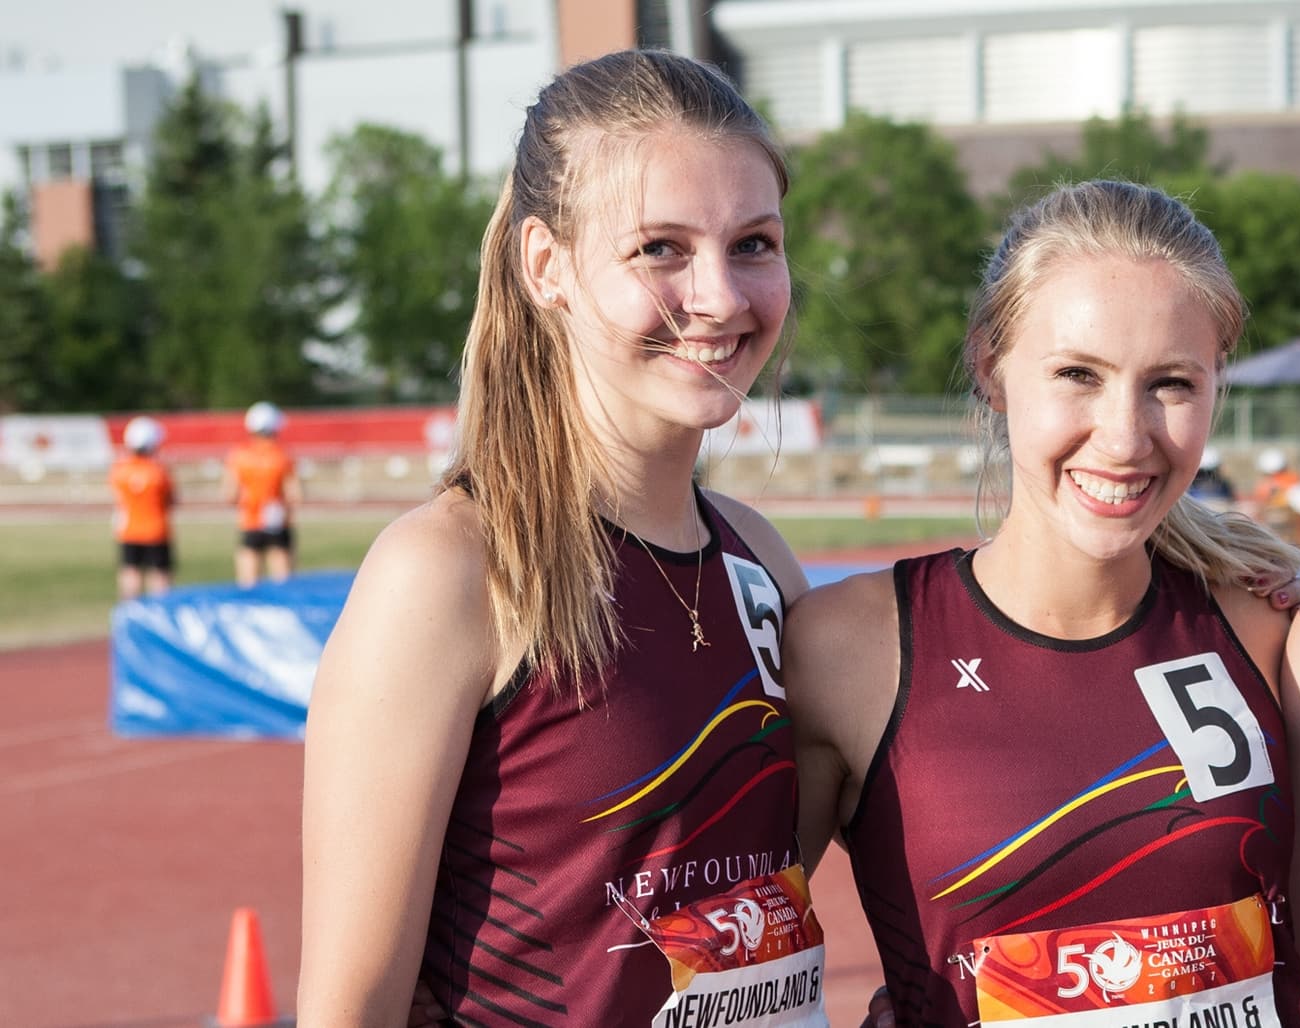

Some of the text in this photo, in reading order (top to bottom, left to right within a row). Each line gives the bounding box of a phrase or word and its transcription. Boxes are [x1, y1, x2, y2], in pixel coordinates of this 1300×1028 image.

[733, 563, 784, 688] 5
[1164, 664, 1250, 786] 5
[605, 850, 794, 906] NEWFOUNDLA
[767, 906, 798, 926] CANADA
[1140, 918, 1216, 940] WINNIPEG
[1156, 933, 1206, 953] JEUX DU
[1148, 944, 1217, 968] CANADA
[1161, 961, 1206, 978] GAMES
[1147, 971, 1216, 995] 2017
